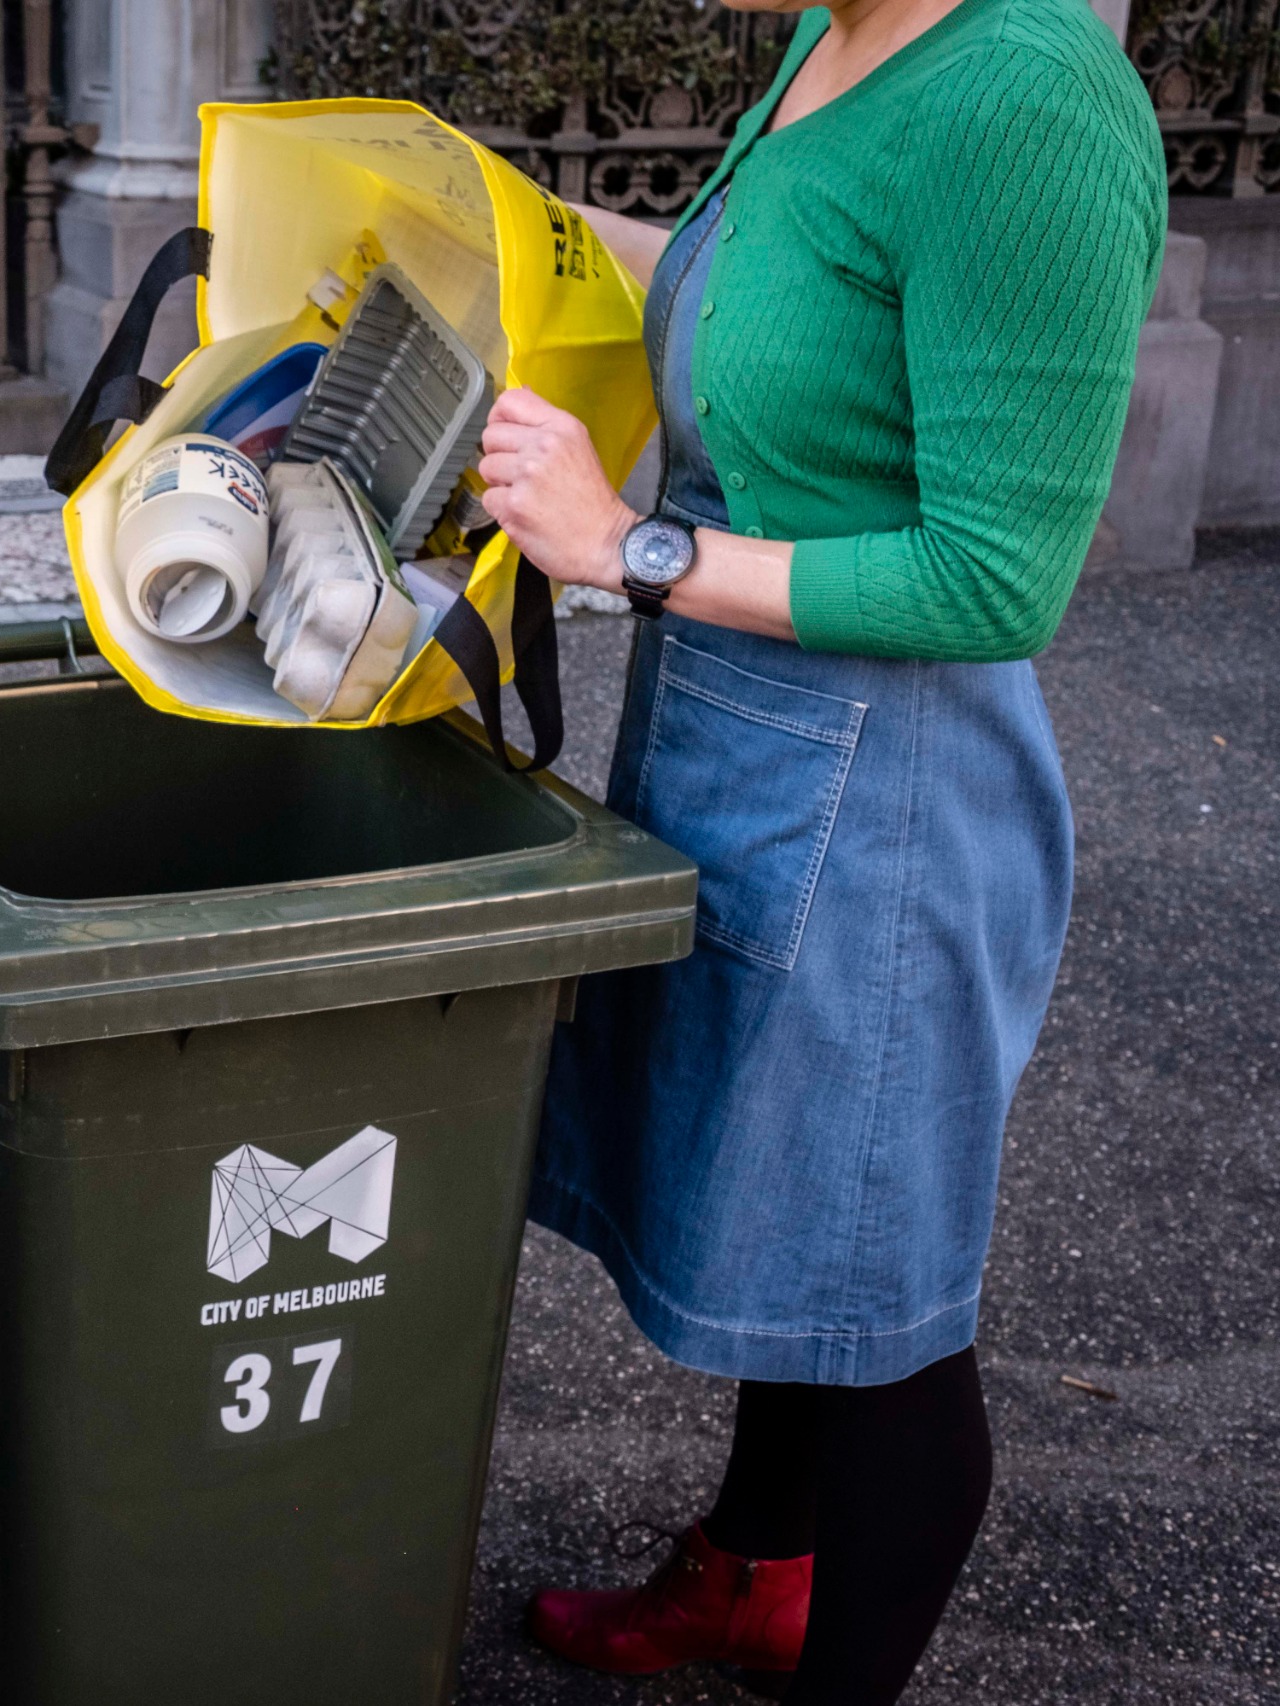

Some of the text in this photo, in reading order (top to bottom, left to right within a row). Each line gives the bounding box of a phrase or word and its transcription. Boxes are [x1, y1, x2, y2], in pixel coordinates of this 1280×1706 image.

[200, 1274, 386, 1326] CITY OF MELBOURNE
